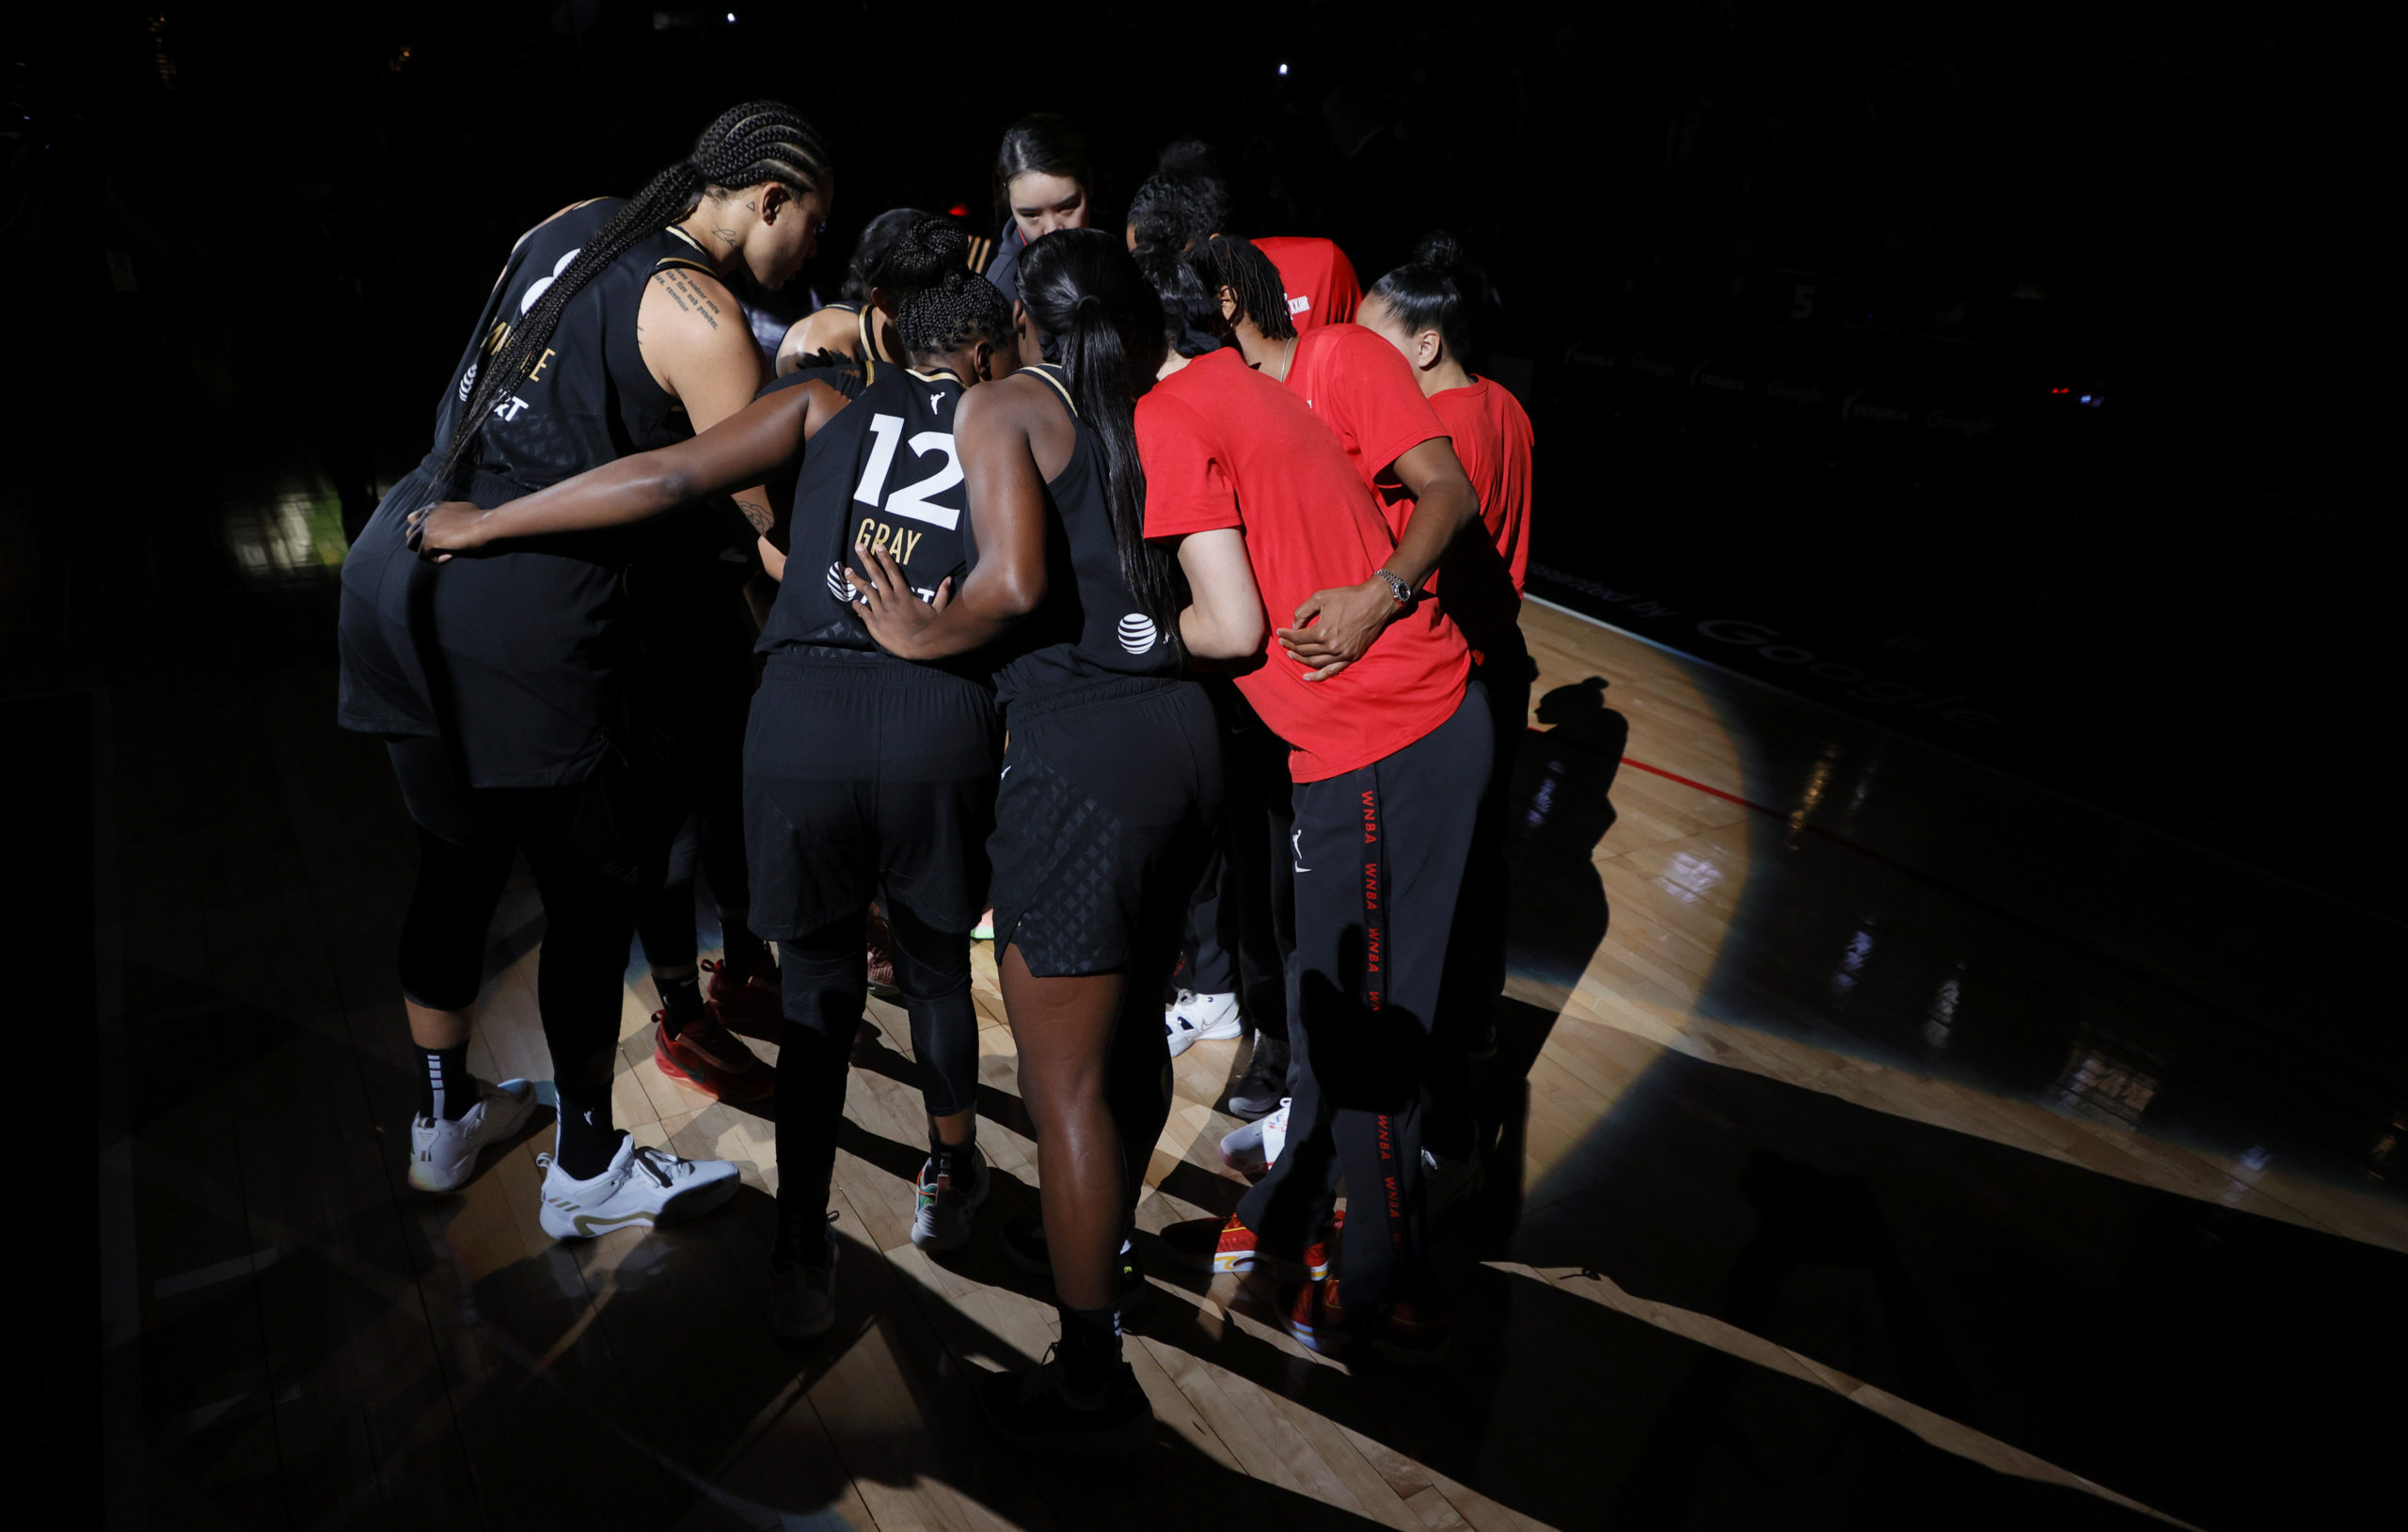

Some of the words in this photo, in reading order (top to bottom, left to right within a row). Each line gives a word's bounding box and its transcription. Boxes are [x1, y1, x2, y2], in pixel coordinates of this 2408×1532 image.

[1789, 285, 1816, 321] 5
[1853, 403, 1909, 423] WNBA
[1925, 409, 1994, 436] Google
[853, 412, 965, 531] 12
[855, 517, 922, 566] GRAY
[1696, 618, 2003, 730] Google
[1361, 790, 1377, 844] WNBA
[1365, 862, 1378, 909] WNBA
[1369, 927, 1380, 973] WNBA
[1369, 990, 1381, 1012] WN
[1377, 1114, 1390, 1160] WNBA
[1385, 1176, 1401, 1219] WNBA
